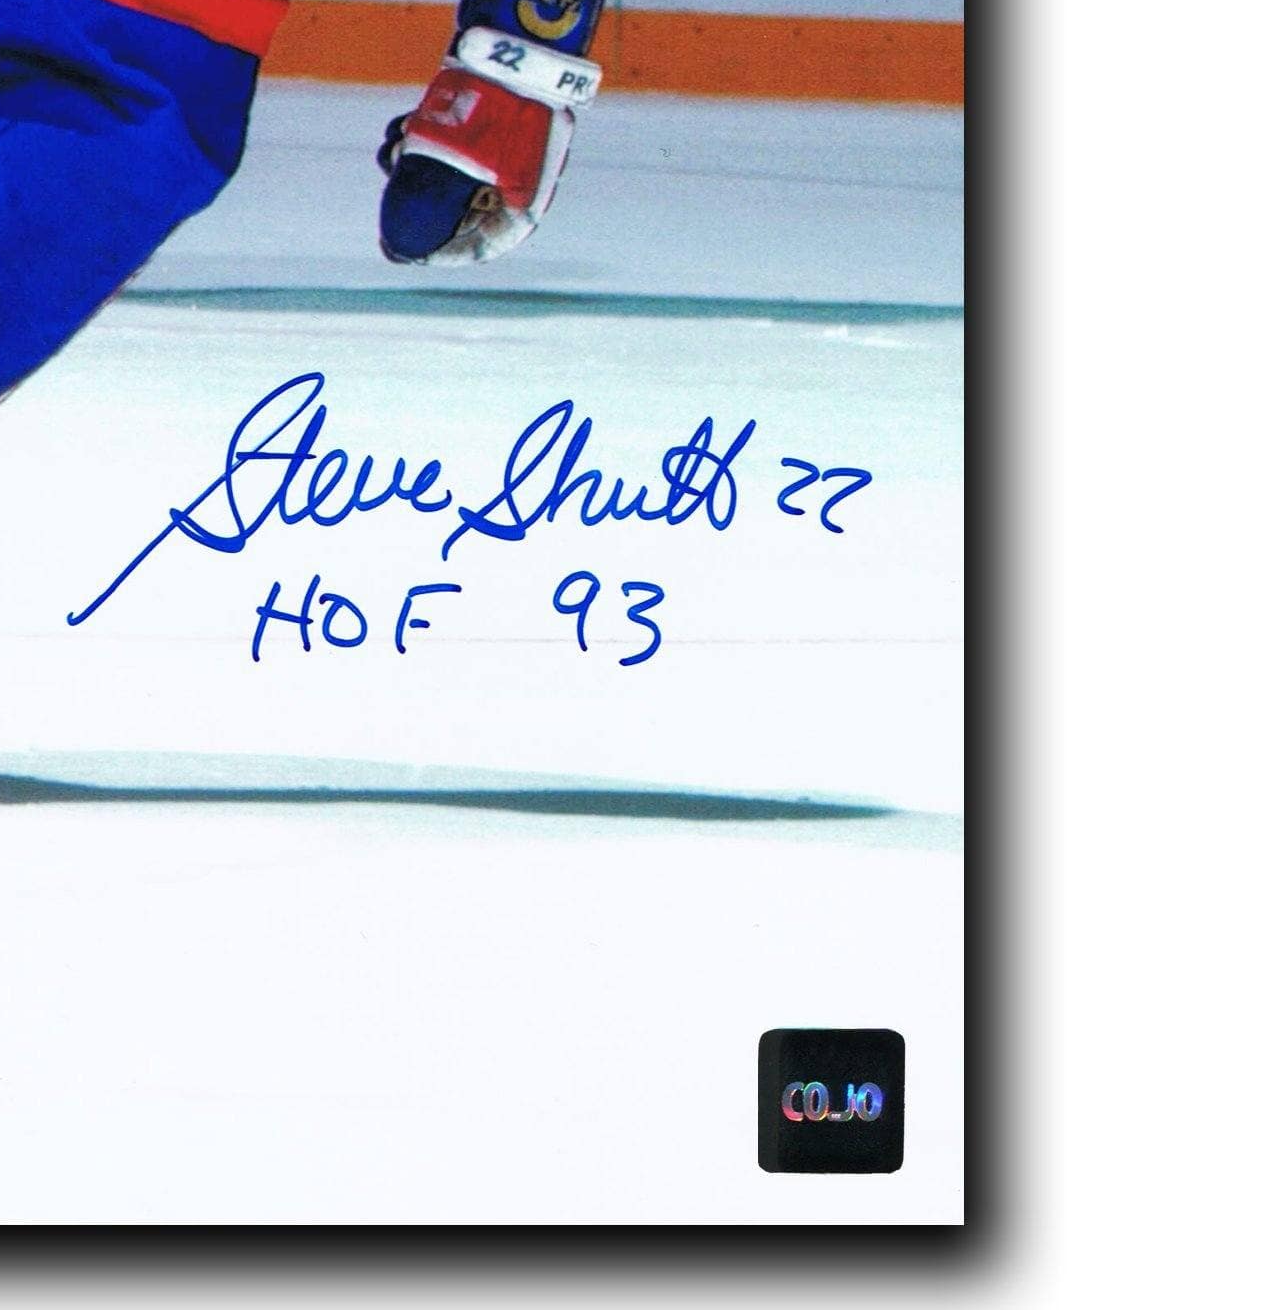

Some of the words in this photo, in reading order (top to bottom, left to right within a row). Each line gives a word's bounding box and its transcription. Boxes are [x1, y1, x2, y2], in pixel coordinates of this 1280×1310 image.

[488, 40, 526, 72] 22
[556, 70, 593, 95] PR
[67, 372, 451, 625] Steve
[442, 400, 756, 559] Shutt
[776, 457, 873, 533] 22
[552, 570, 665, 666] 93
